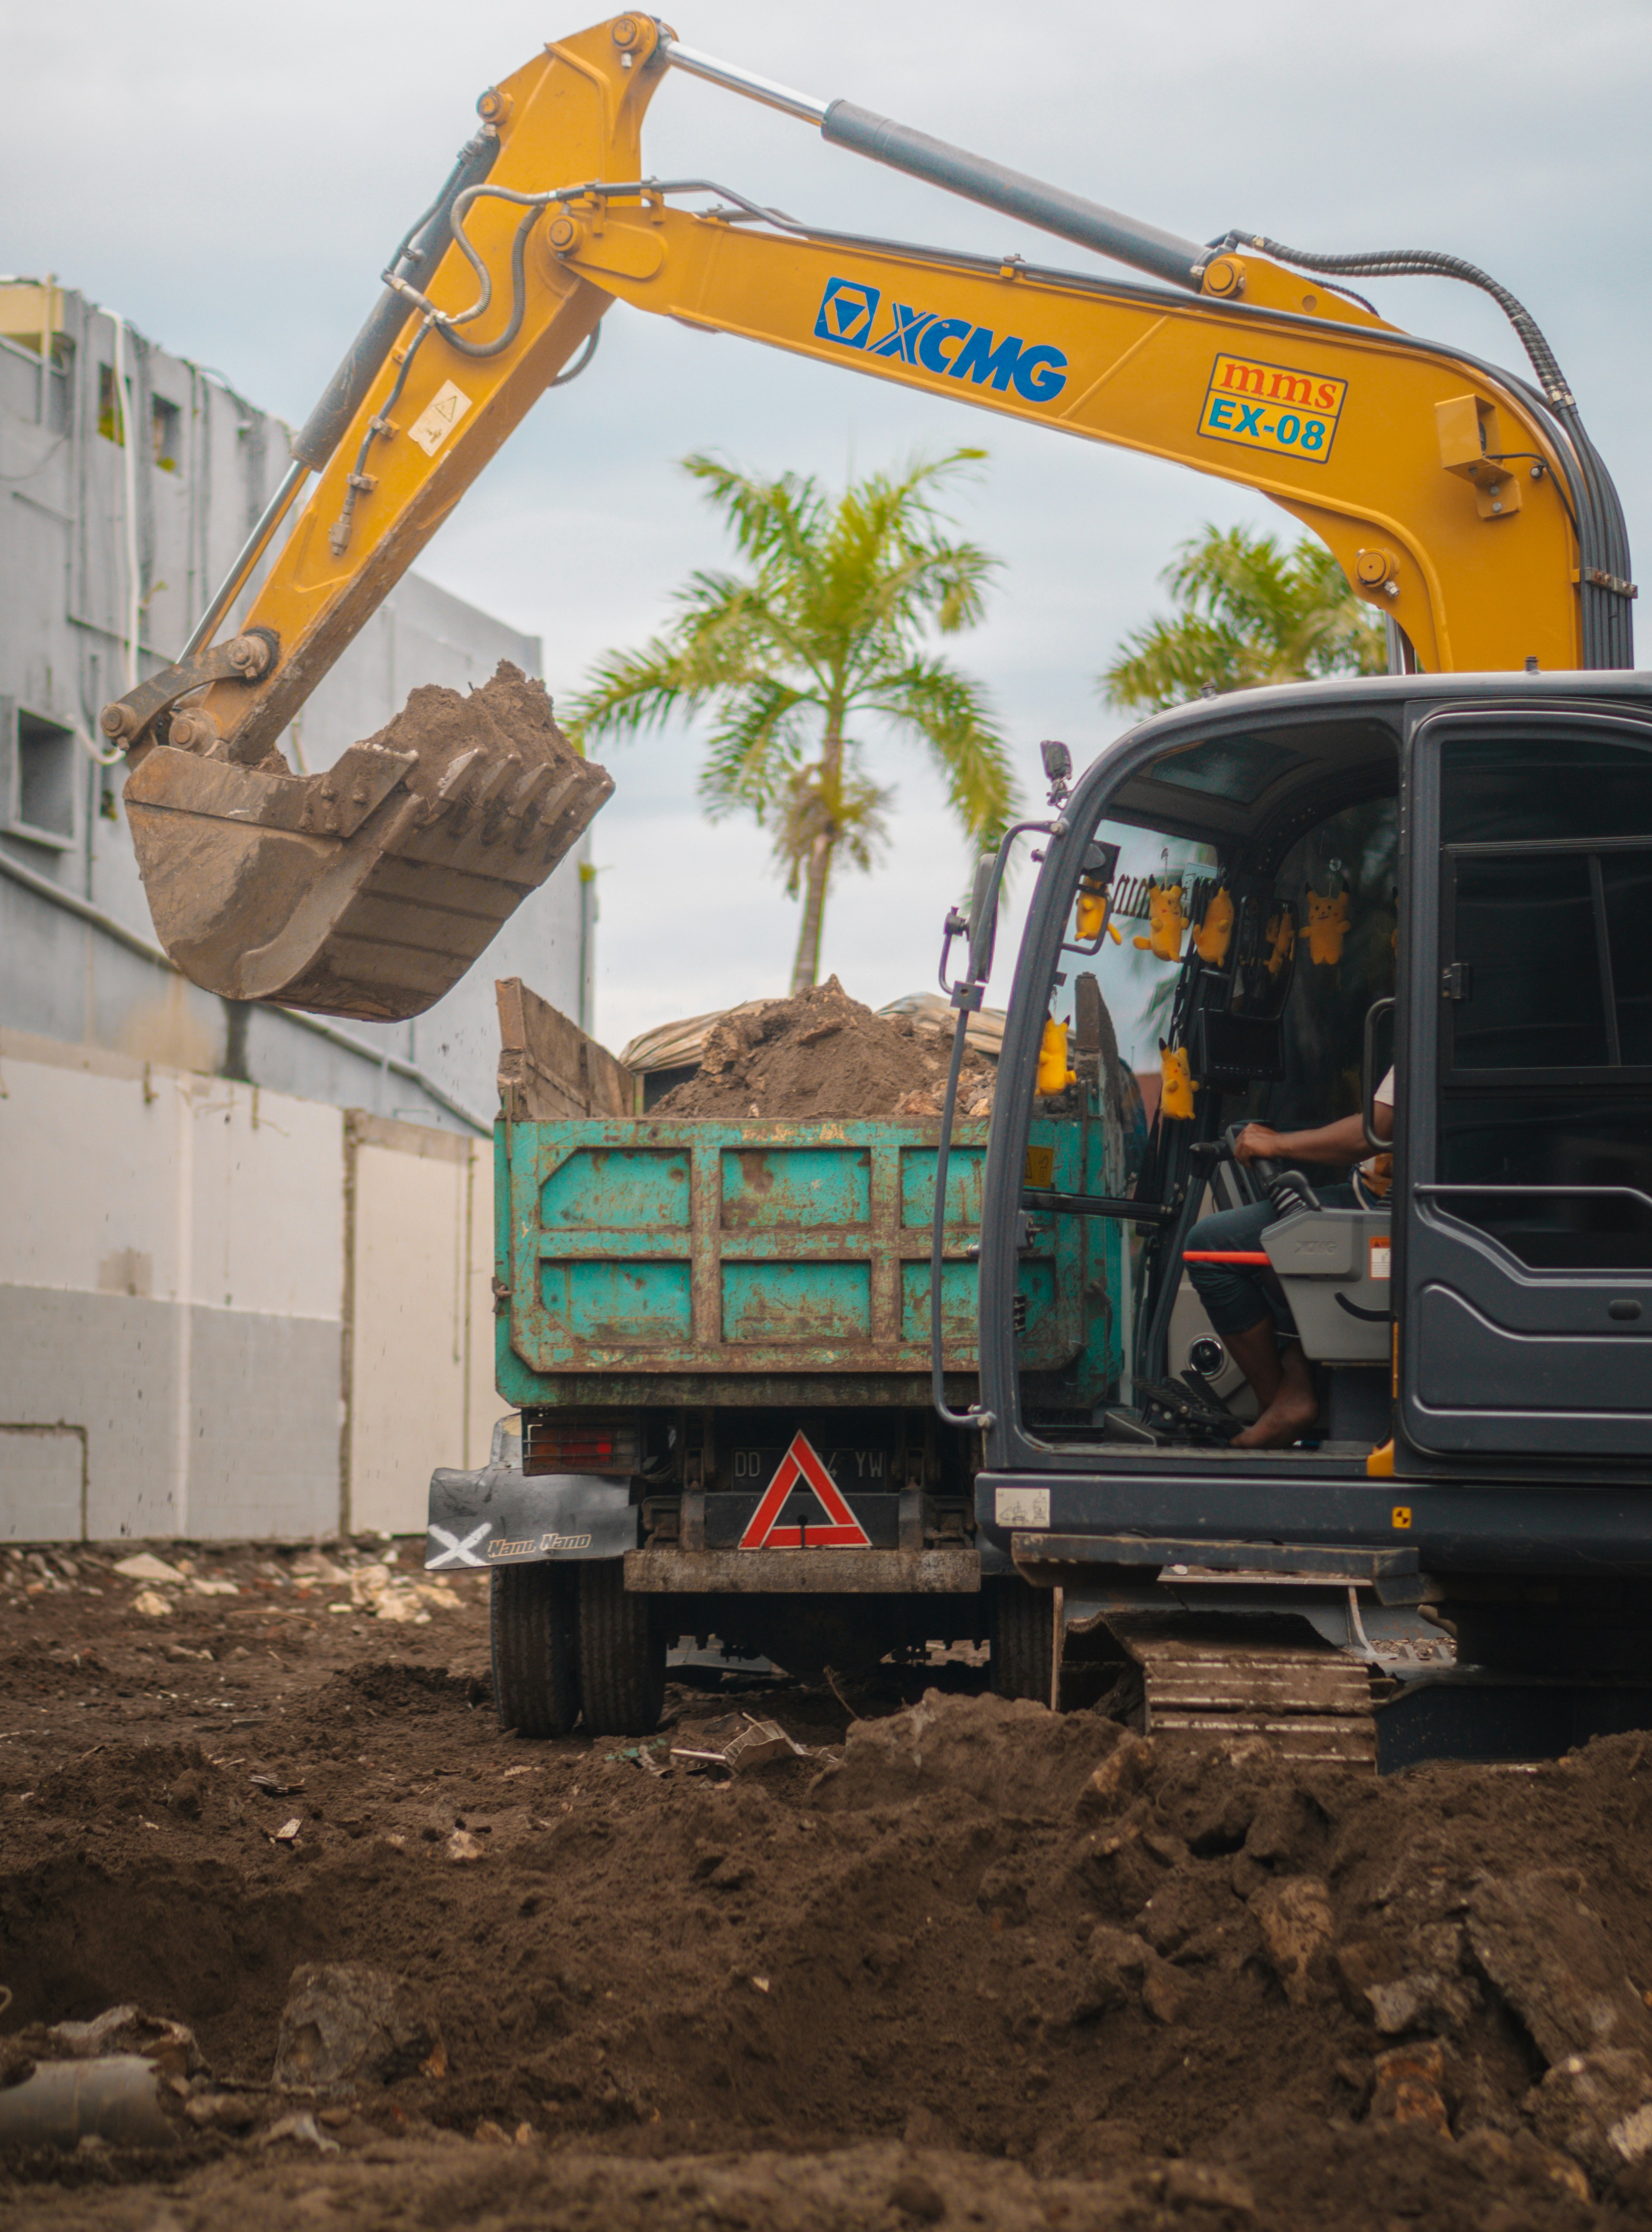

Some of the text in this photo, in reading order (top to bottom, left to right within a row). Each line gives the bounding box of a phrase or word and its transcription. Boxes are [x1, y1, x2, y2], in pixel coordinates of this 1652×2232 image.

[865, 301, 1068, 402] XCMG
[1220, 363, 1337, 409] mms
[1208, 398, 1325, 451] EX-08
[734, 1451, 760, 1477] DD
[854, 1451, 882, 1477] YW
[540, 1533, 592, 1551] Nano
